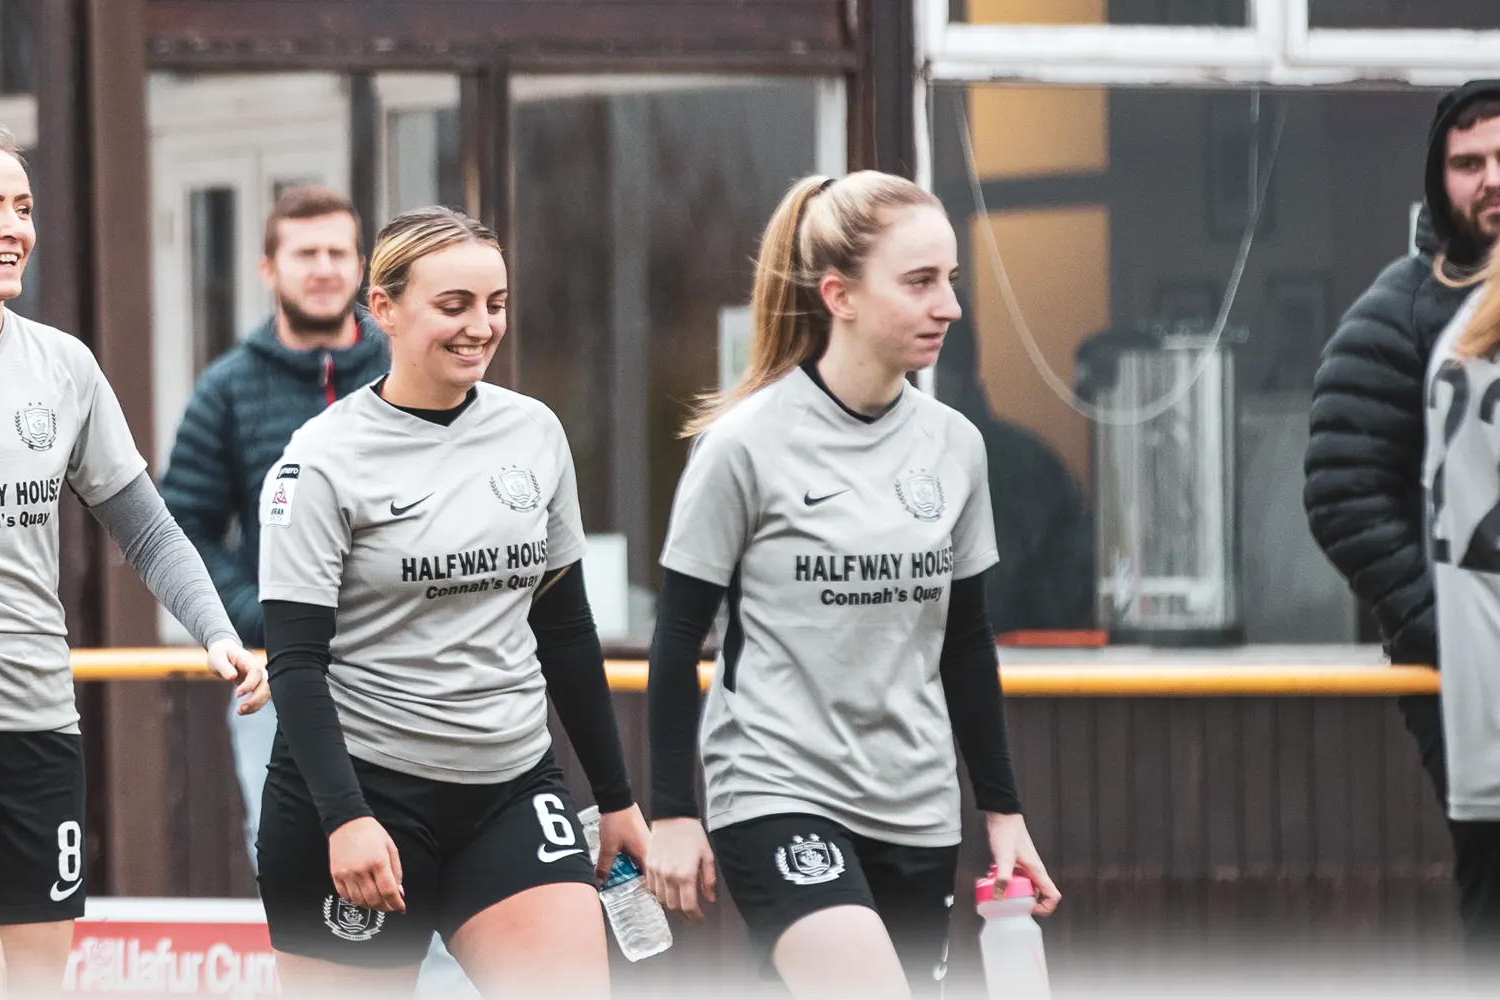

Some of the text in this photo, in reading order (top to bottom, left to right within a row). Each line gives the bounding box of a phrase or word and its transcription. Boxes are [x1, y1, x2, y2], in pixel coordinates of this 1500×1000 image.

[19, 510, 51, 528] Quay
[401, 547, 499, 582] HALFWAY
[795, 553, 903, 581] HALFWAY
[425, 573, 540, 600] Connah's Quay
[820, 584, 944, 606] Connah's Quay
[532, 793, 576, 846] 6
[57, 820, 82, 882] 8
